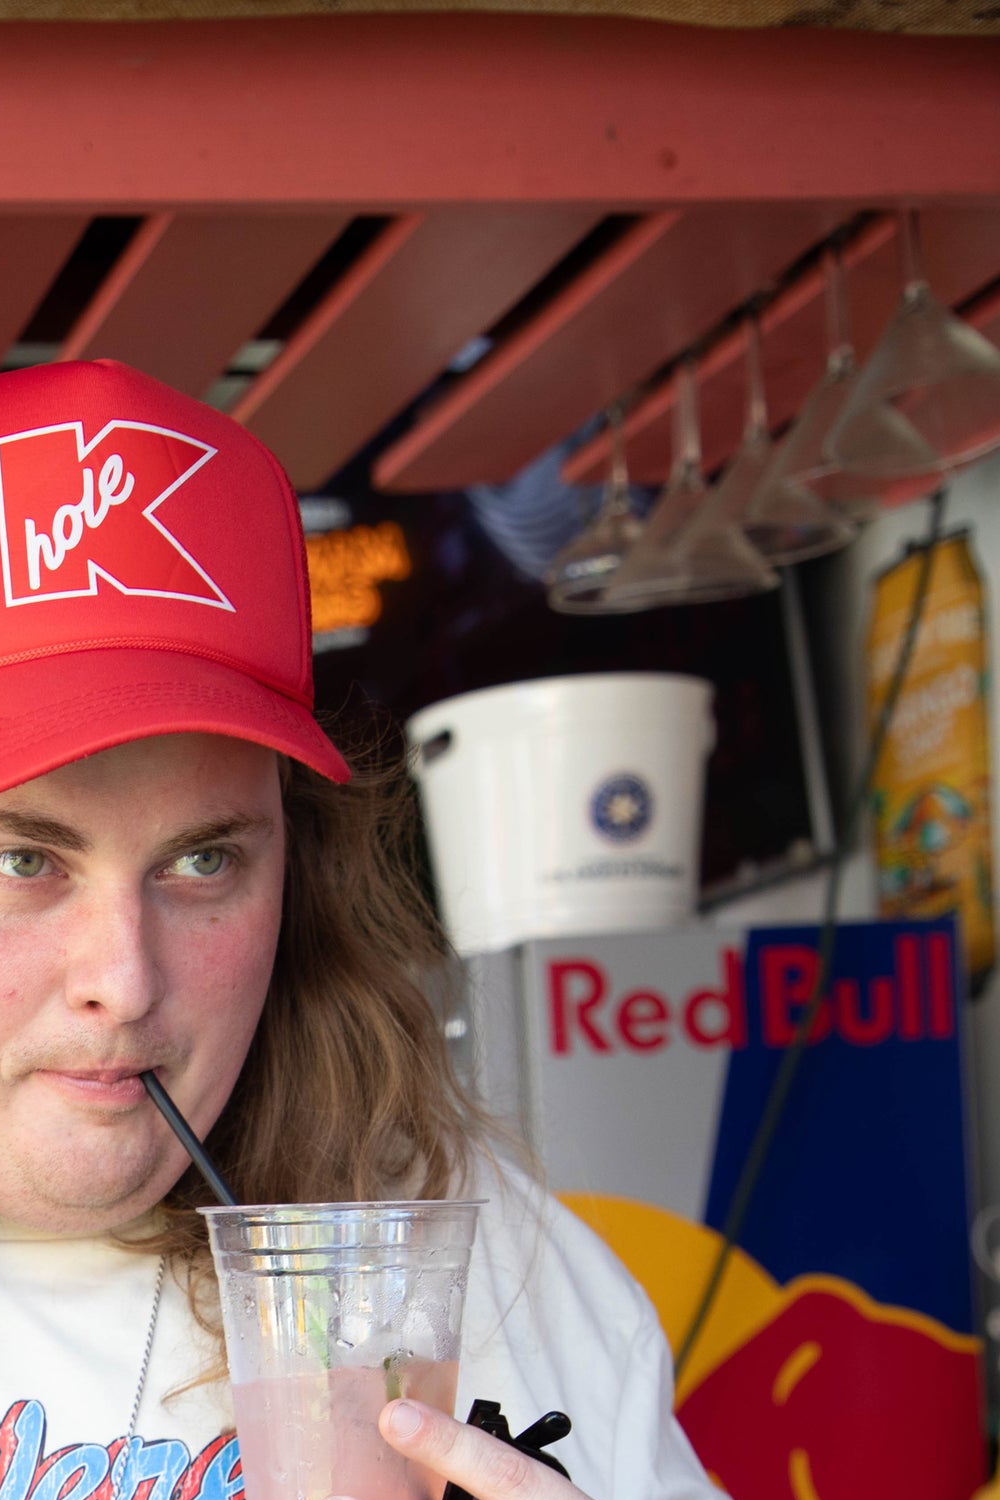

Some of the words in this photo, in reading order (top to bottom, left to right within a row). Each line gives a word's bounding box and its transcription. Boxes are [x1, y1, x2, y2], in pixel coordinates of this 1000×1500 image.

[24, 453, 135, 591] hole
[546, 943, 748, 1058] Red
[757, 931, 956, 1049] Bull
